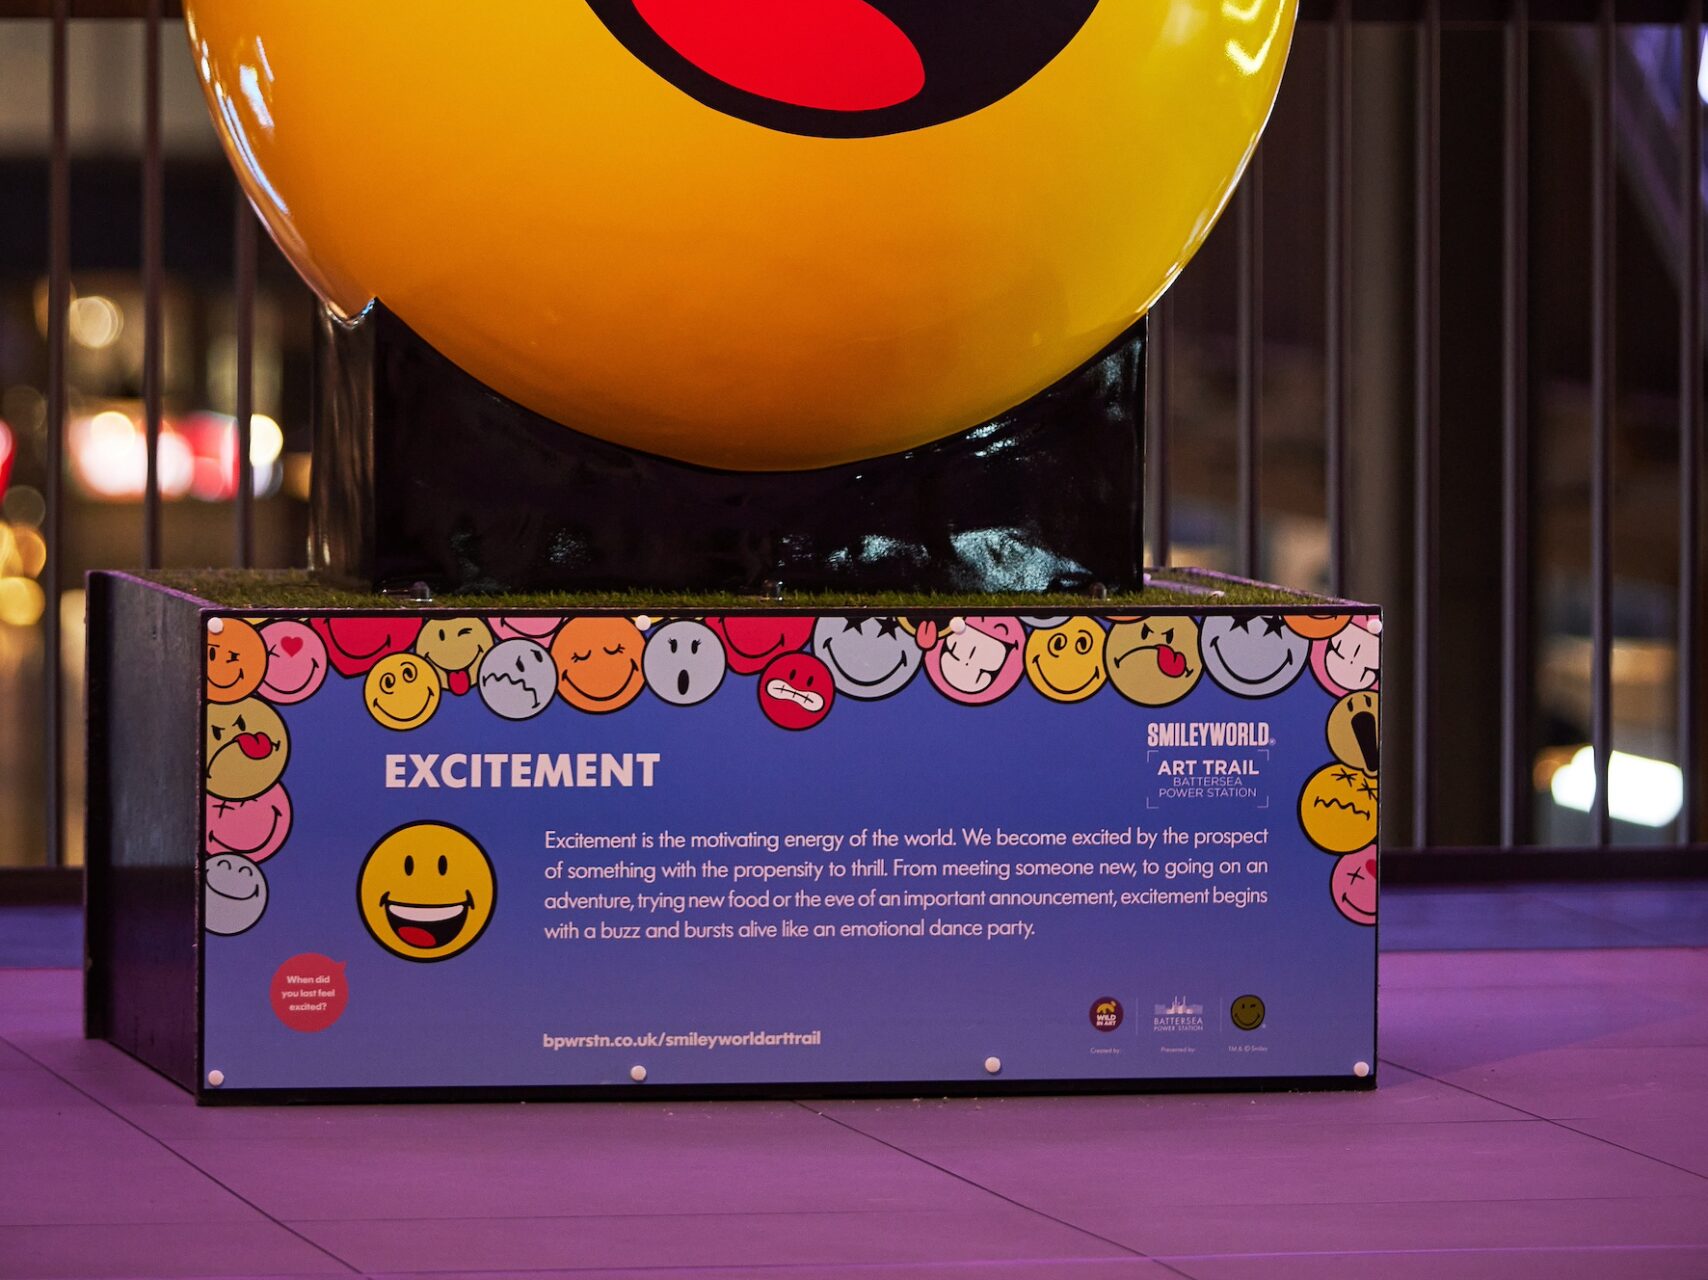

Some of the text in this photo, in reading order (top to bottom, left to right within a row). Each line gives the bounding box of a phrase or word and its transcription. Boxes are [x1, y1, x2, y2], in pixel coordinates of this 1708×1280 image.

[385, 753, 661, 788] EXCITEMENT
[1157, 759, 1260, 775] ART TRAIL
[1173, 776, 1242, 787] BATTERSEA
[1159, 787, 1257, 798] POWER STATION
[545, 826, 1269, 852] Excitement is the motivating energy of the world. We become excited by the prospect
[545, 858, 1268, 883] of something with the propensity to thrill. From meeting someone new, to going on an
[545, 886, 1268, 912] adventure, trying new food or the eve of an important announcement, excitement begins
[545, 919, 1035, 940] with a buzz and bursts alive like an emotional dance party.
[287, 975, 330, 983] When did
[281, 989, 336, 999] you last feel
[289, 1002, 327, 1011] excited?
[1153, 1017, 1204, 1025] BATTERSEA
[543, 1031, 821, 1050] bpwrstn.co.uk/smileyworldarttrail
